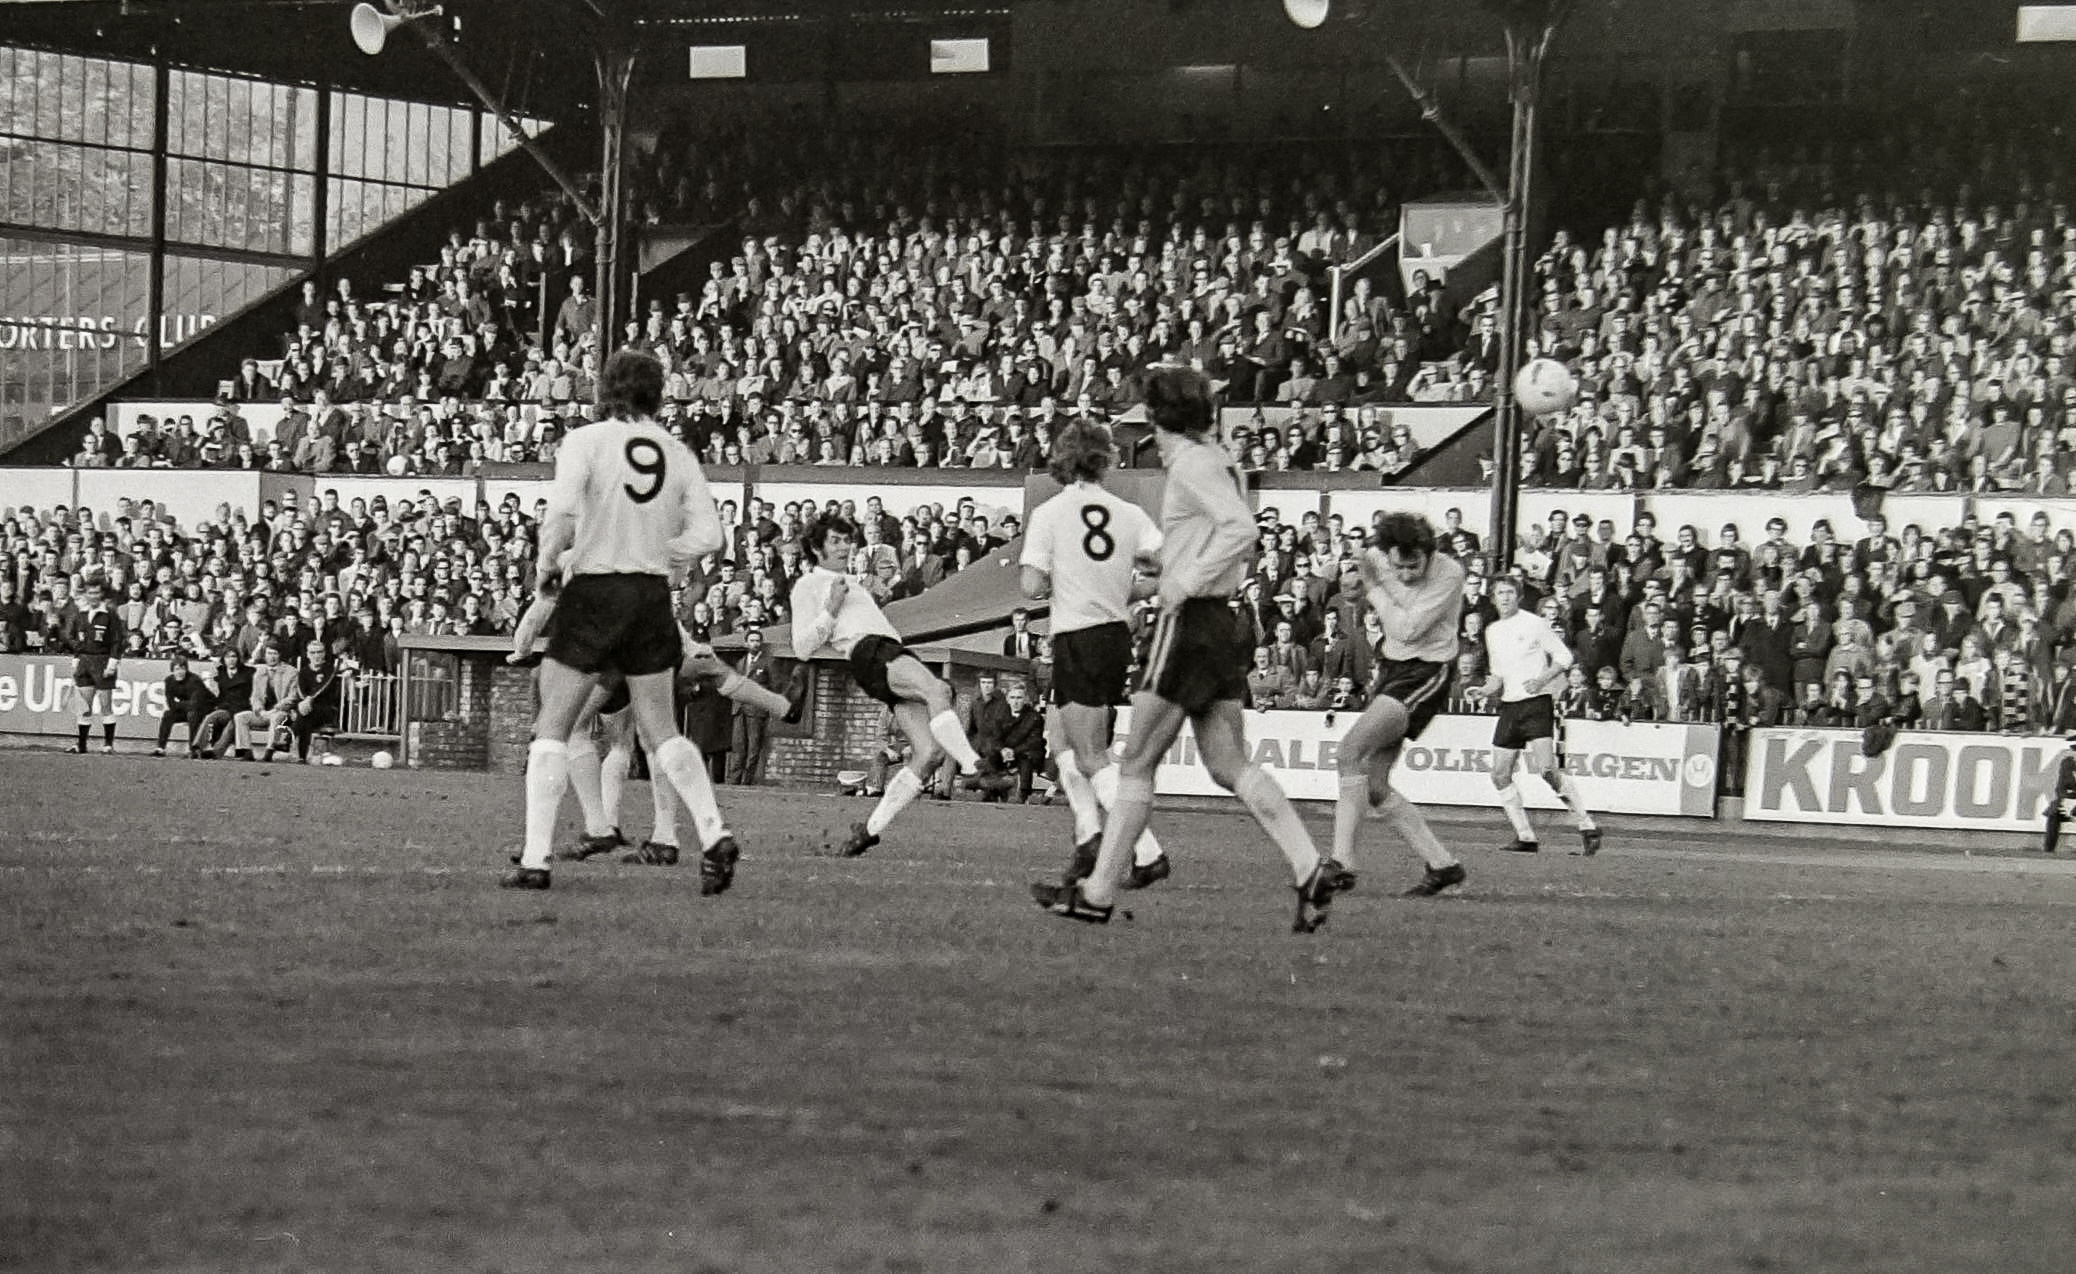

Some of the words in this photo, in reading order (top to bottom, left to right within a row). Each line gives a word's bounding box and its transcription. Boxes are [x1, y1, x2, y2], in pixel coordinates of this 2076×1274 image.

[624, 437, 667, 504] 9
[1081, 503, 1115, 562] 8
[1403, 746, 1680, 782] OLKAGEN
